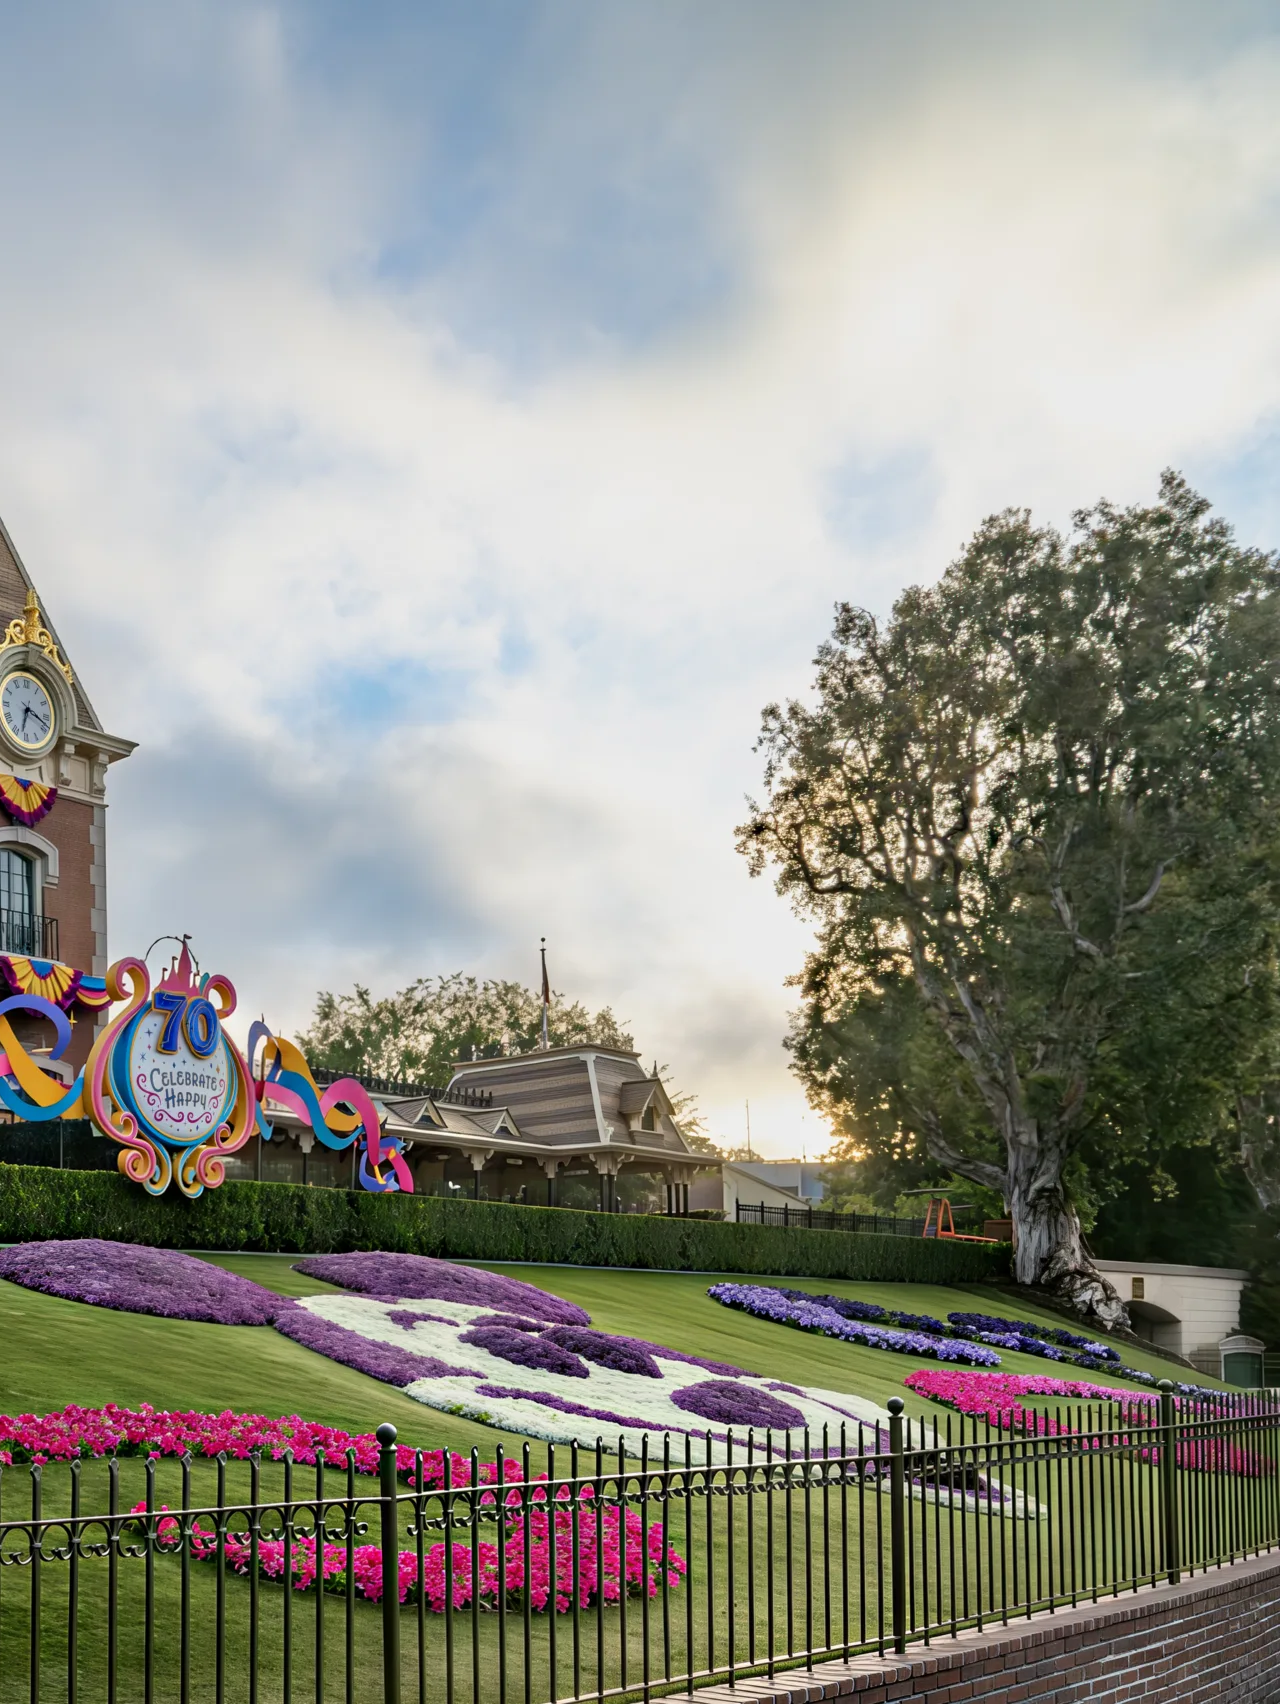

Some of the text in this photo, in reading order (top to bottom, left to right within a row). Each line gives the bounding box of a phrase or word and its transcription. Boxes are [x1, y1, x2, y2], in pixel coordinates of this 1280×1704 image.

[152, 990, 219, 1059] 70
[150, 1068, 217, 1092] CELEBRATE
[165, 1088, 207, 1110] HAPPY
